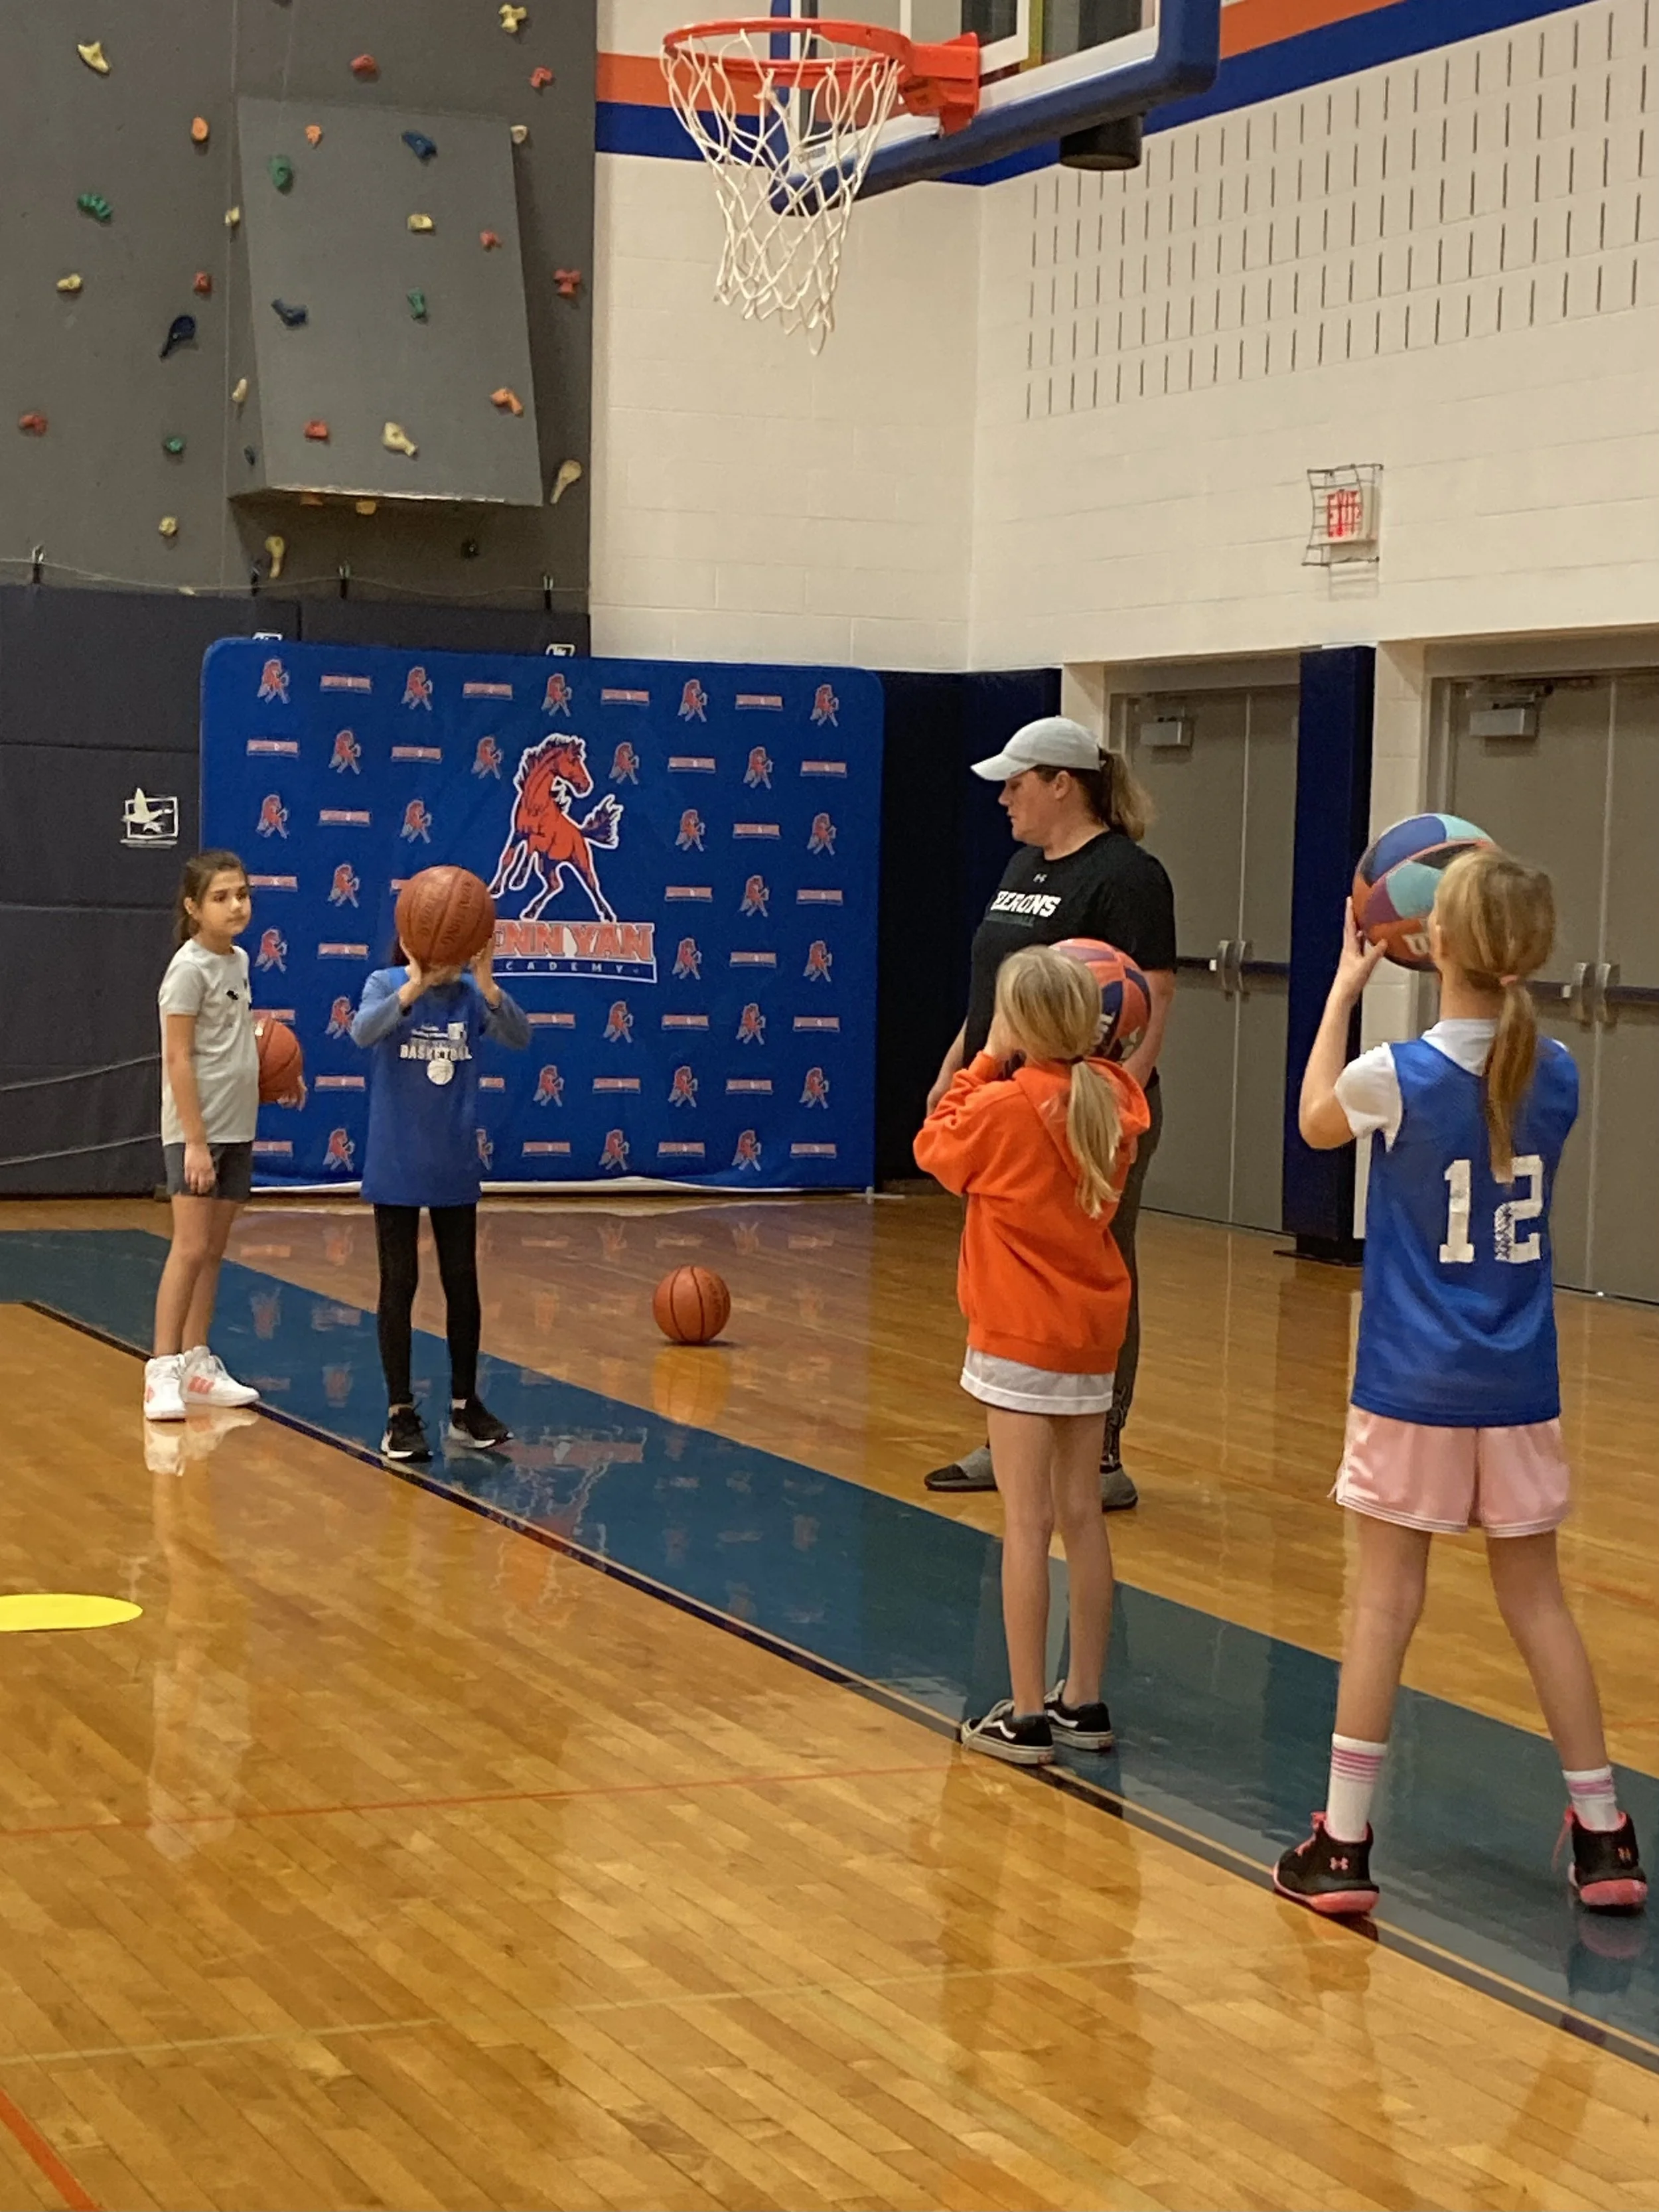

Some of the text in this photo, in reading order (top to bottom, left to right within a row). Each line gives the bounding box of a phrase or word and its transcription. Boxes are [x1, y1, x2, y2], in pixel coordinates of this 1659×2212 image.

[568, 923, 653, 961] YAN
[506, 962, 624, 974] CADEMY
[1439, 1155, 1542, 1264] 12
